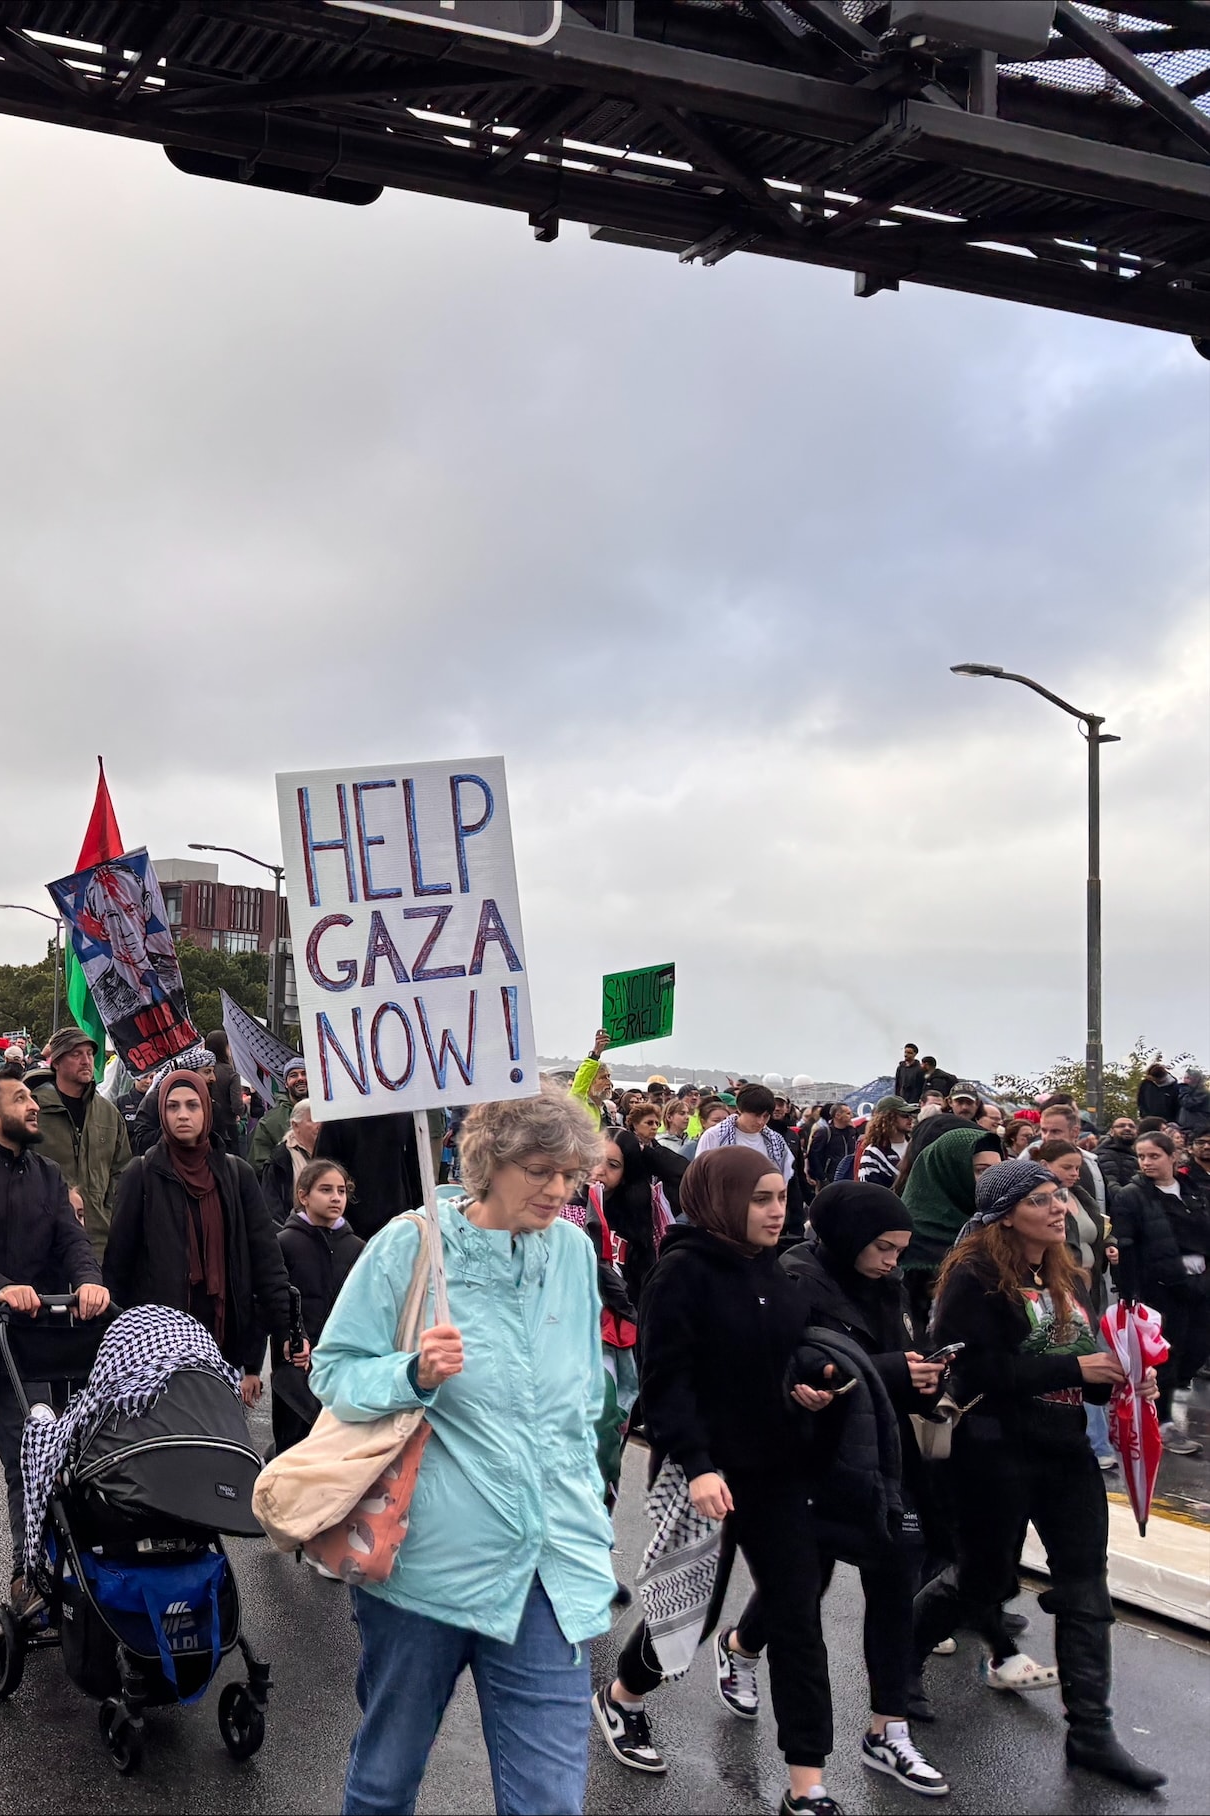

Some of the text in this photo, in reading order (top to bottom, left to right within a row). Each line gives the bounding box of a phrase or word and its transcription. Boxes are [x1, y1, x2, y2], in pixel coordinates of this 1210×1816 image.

[297, 774, 494, 907] HELP
[306, 899, 523, 992] GAZA
[134, 1002, 174, 1038] WAR
[316, 985, 523, 1101] NOW!
[168, 1633, 199, 1650] LDI
